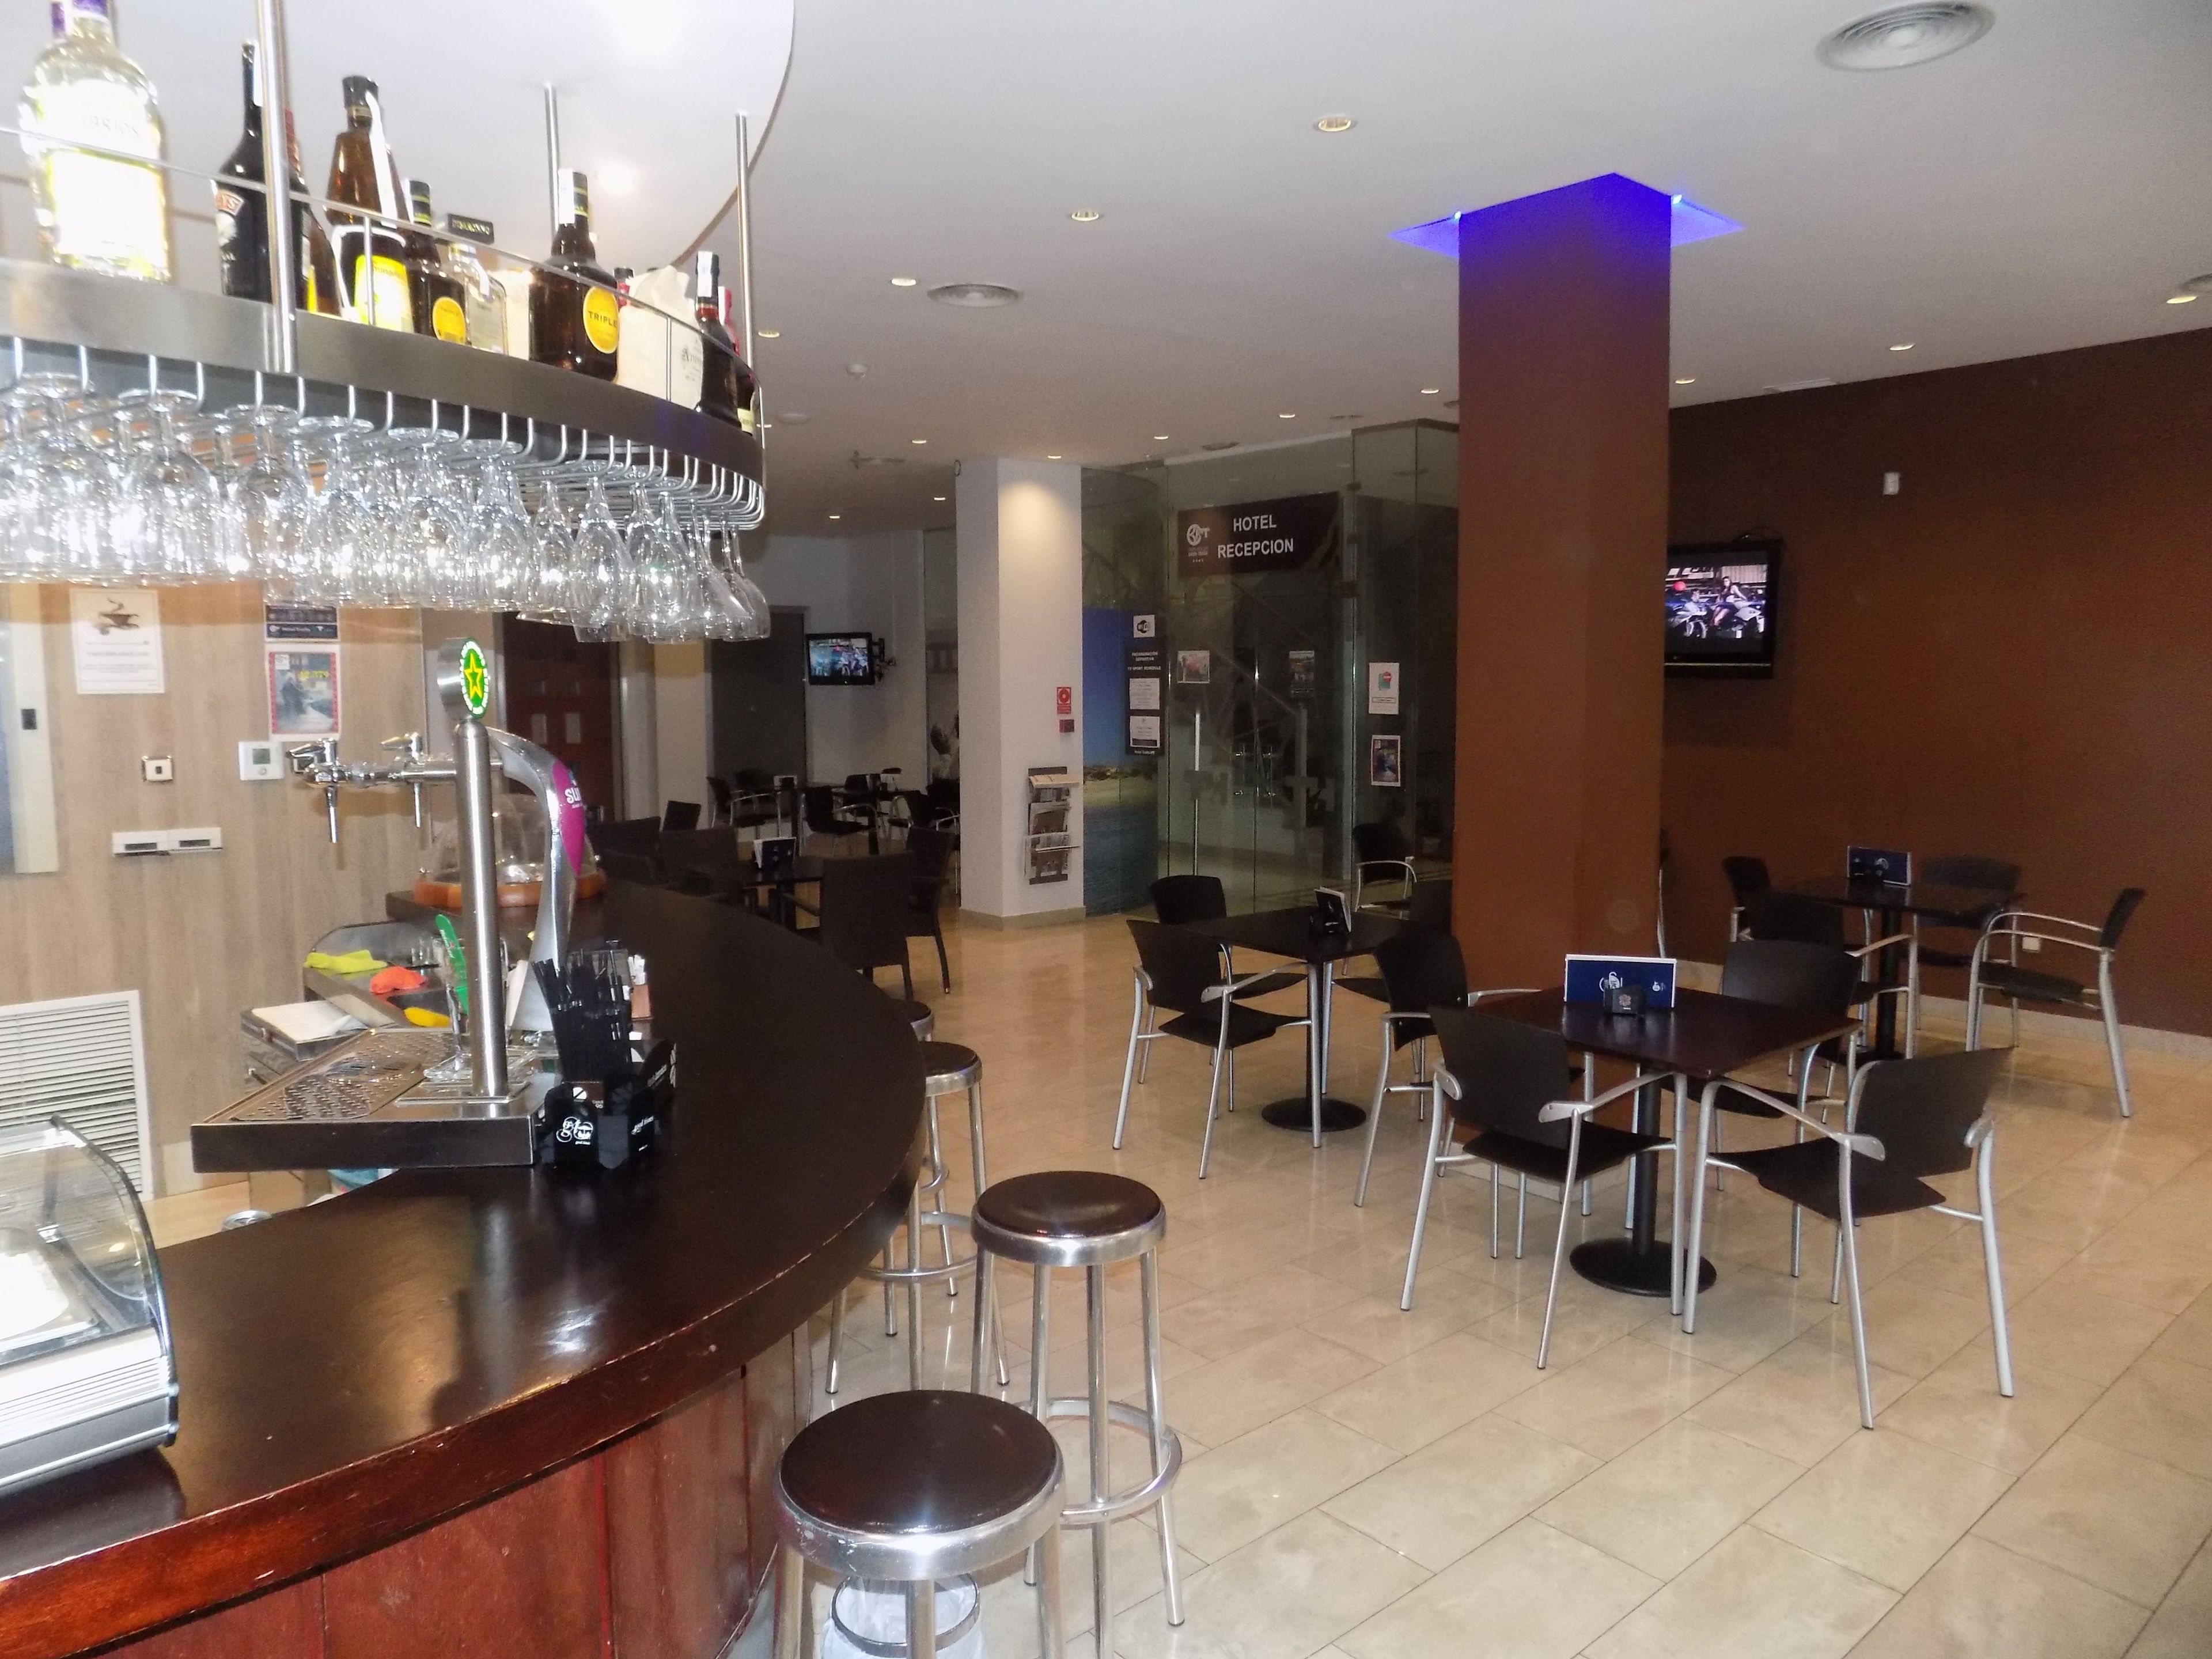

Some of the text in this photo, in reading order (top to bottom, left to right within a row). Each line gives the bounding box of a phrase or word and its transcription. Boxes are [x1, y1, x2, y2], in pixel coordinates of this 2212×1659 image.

[588, 310, 618, 329] TRIPLE
[1233, 514, 1277, 532] HOTEL
[1217, 538, 1294, 558] RECEPCION
